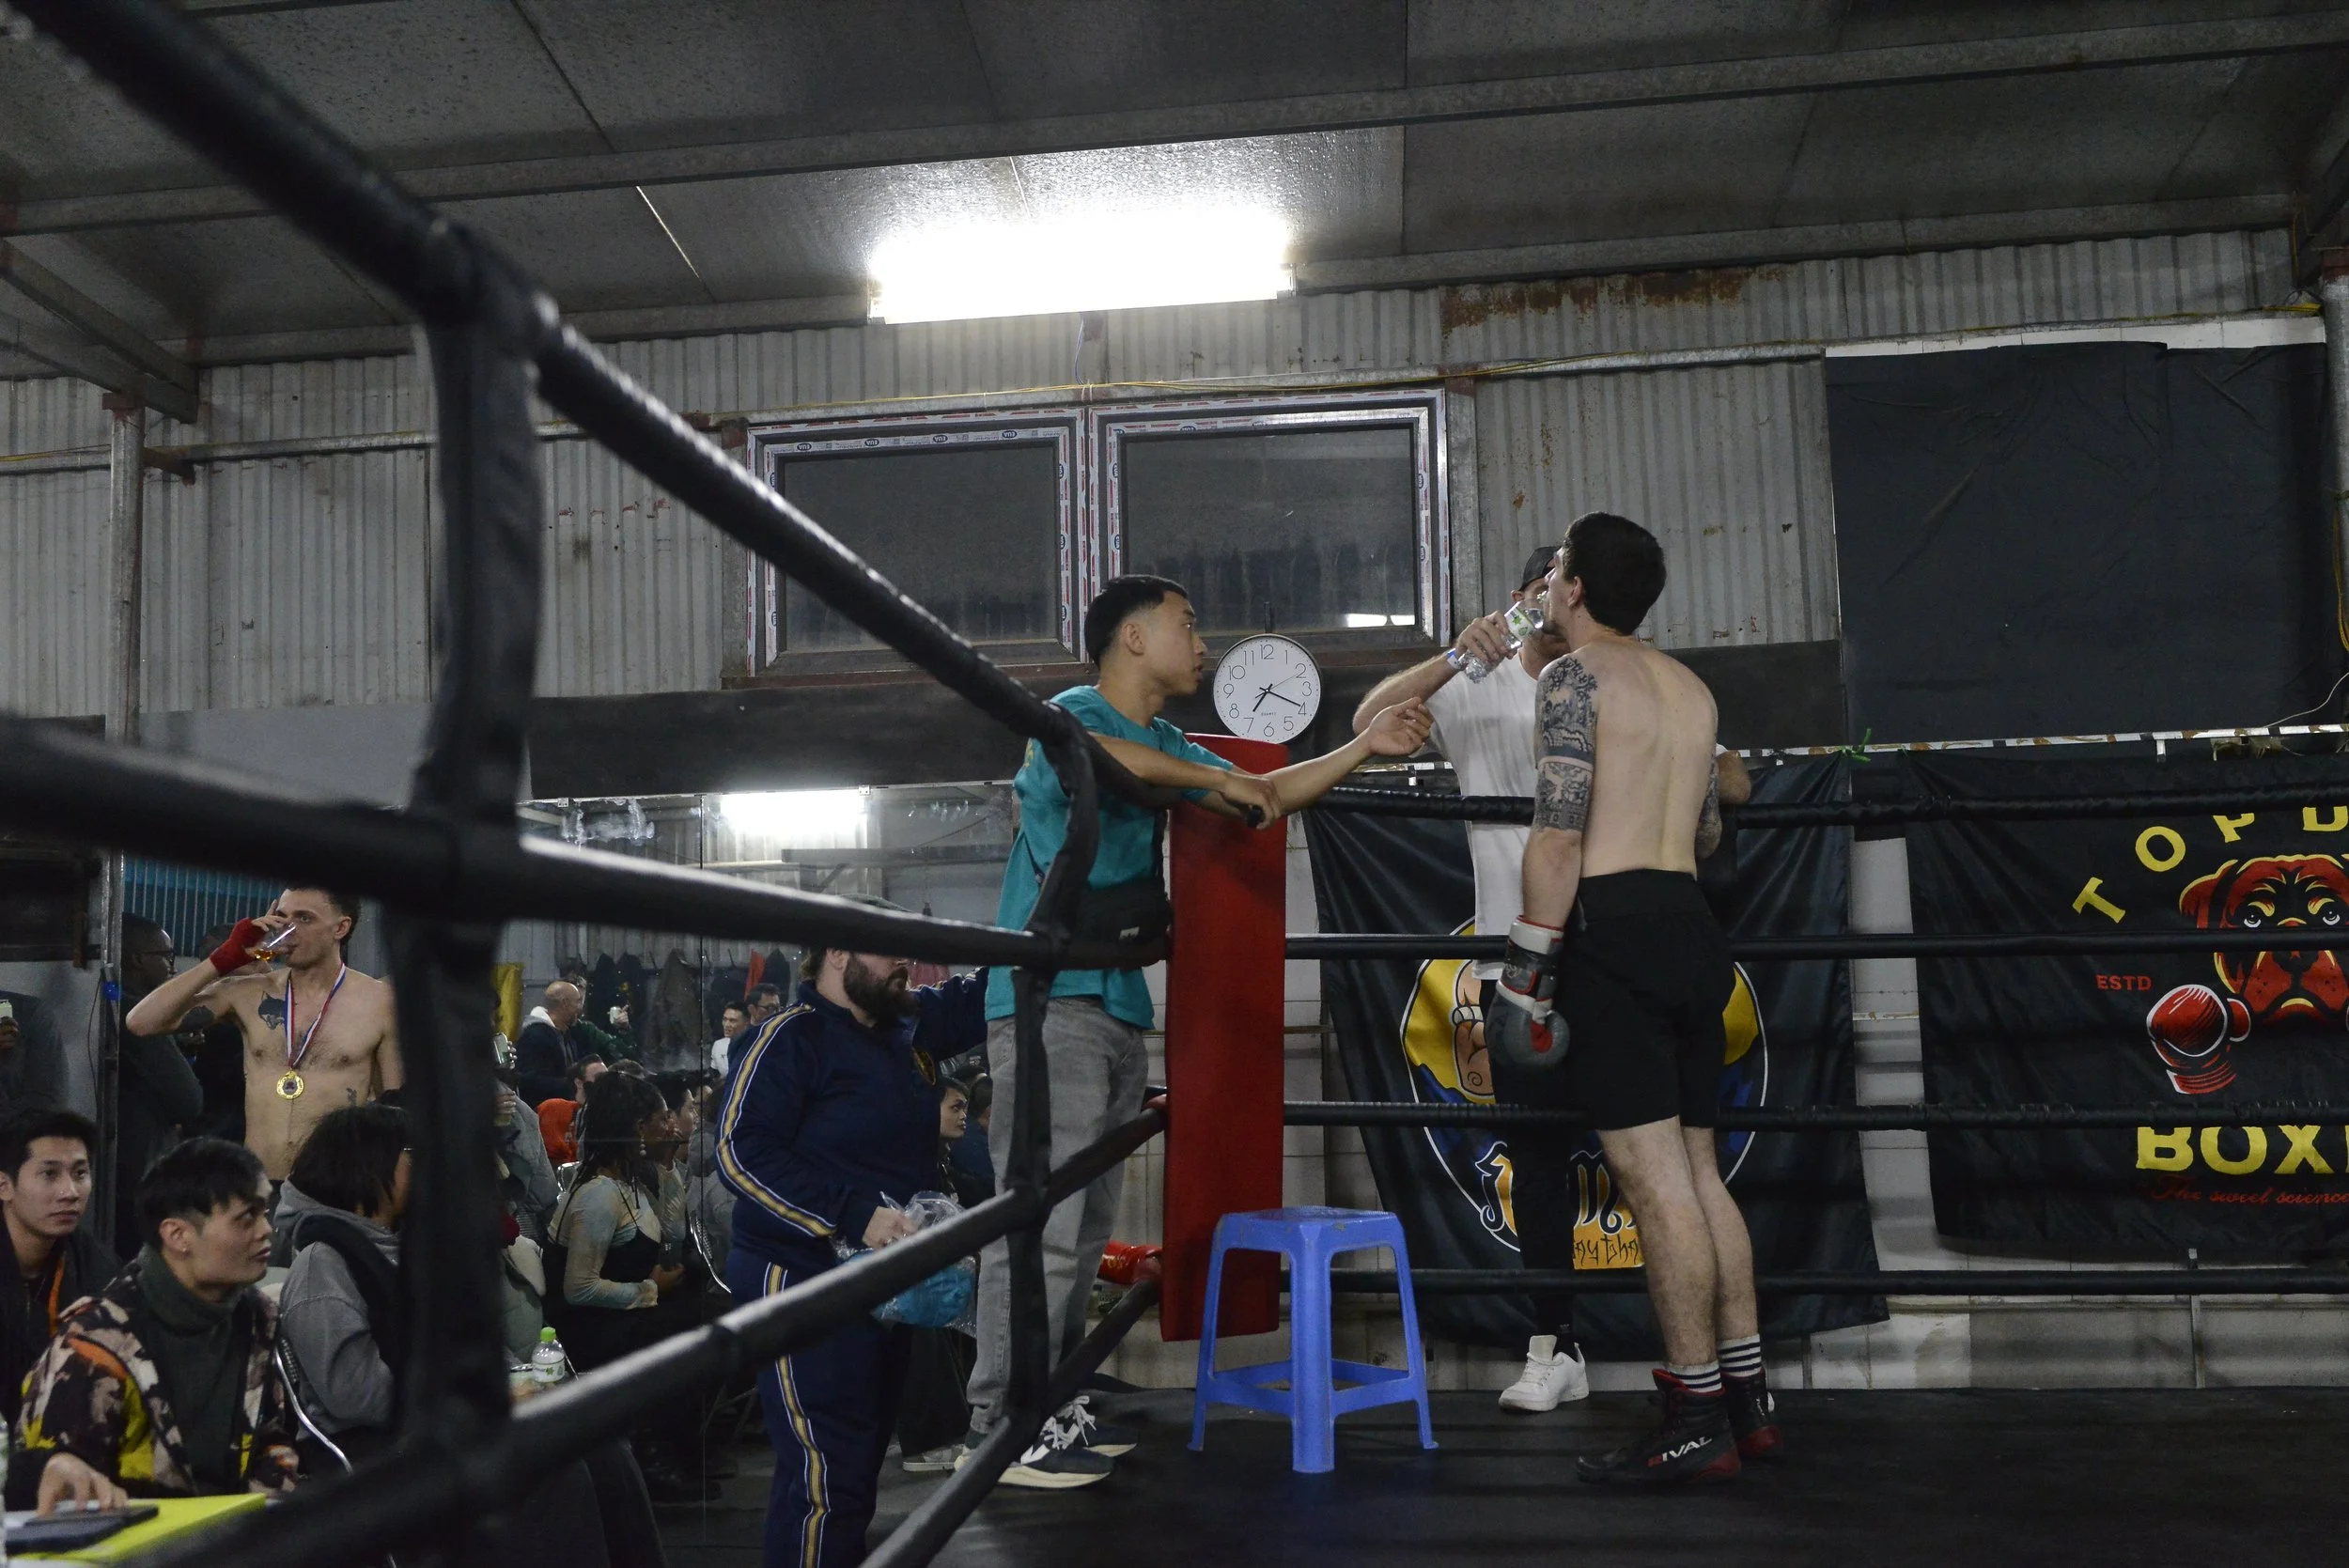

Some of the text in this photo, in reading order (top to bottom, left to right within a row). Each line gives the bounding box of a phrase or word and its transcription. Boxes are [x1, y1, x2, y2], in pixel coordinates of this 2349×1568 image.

[1243, 650, 1254, 666] 11
[1260, 644, 1274, 660] 12
[1284, 649, 1288, 665] 1
[1228, 665, 1246, 680] 10
[1296, 662, 1307, 678] 2
[1223, 683, 1235, 699] 9
[1301, 681, 1312, 696] 3
[1229, 703, 1239, 719] 8
[1298, 702, 1307, 717] 4
[1243, 717, 1254, 733] 7
[1263, 722, 1275, 737] 6
[1283, 716, 1294, 731] 5
[2072, 813, 2255, 924] TOP
[2096, 974, 2152, 991] ESTD
[2135, 1125, 2349, 1175] BOX
[1647, 1436, 1713, 1467] RIVAL
